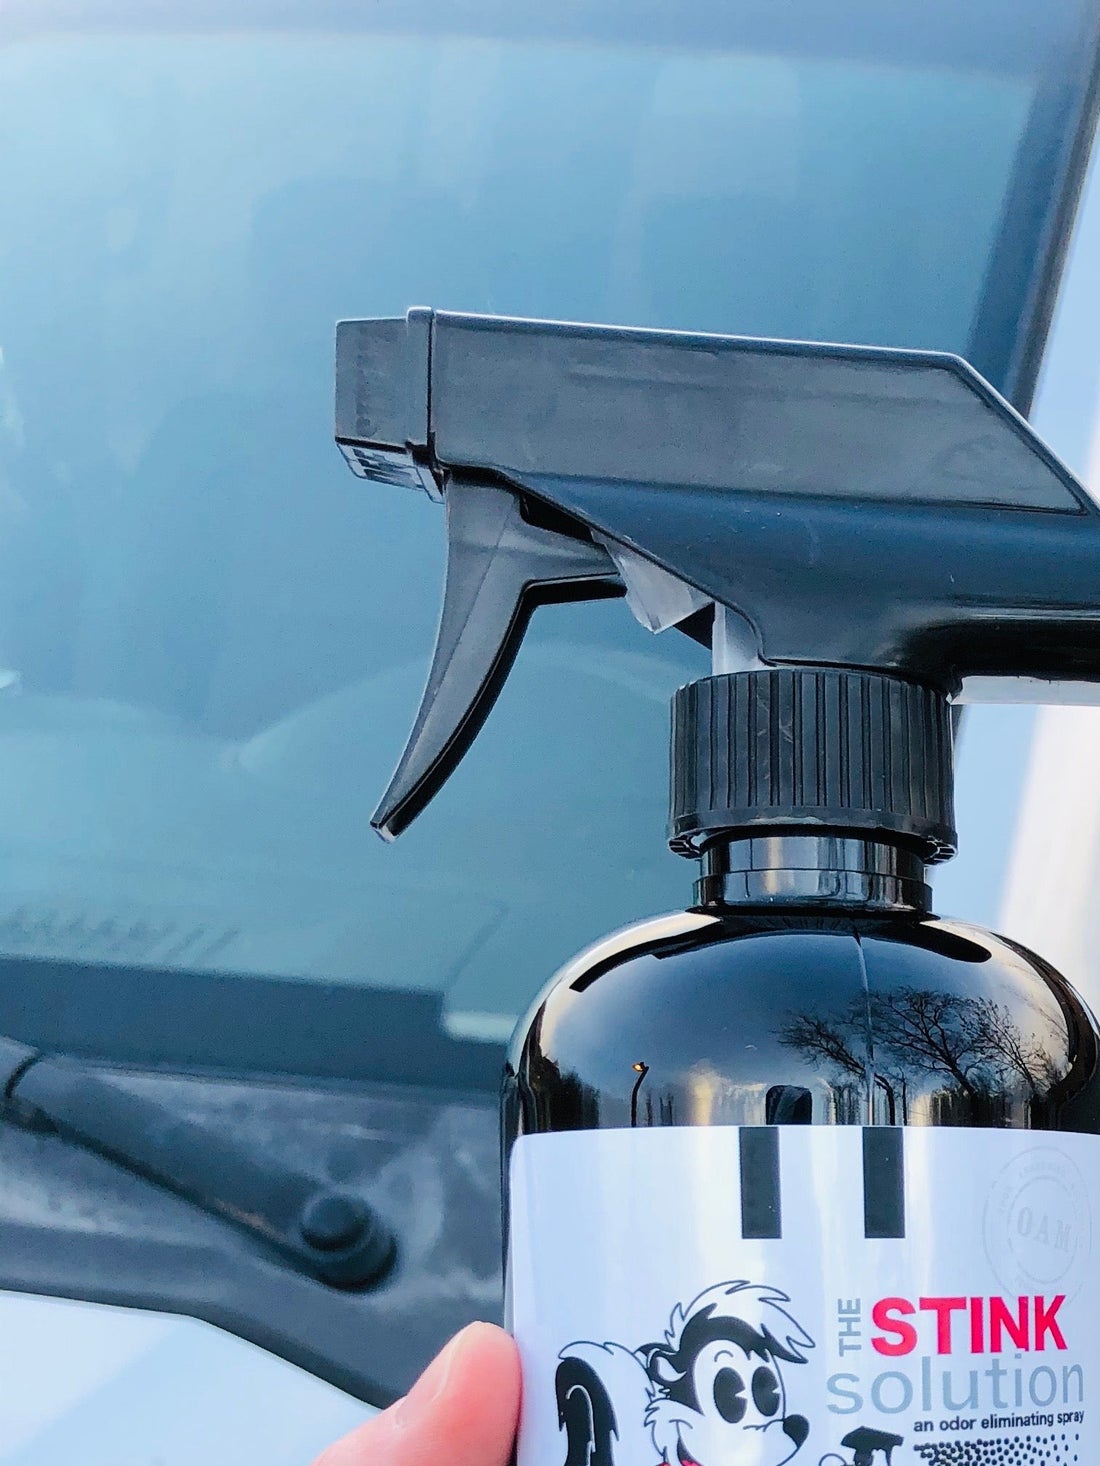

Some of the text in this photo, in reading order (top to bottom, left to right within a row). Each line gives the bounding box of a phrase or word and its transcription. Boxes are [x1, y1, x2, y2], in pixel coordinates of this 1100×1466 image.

[838, 1298, 861, 1357] THE
[870, 1295, 1068, 1356] STINK
[826, 1353, 1084, 1414] solution
[913, 1410, 1085, 1433] an odor eliminating spray
